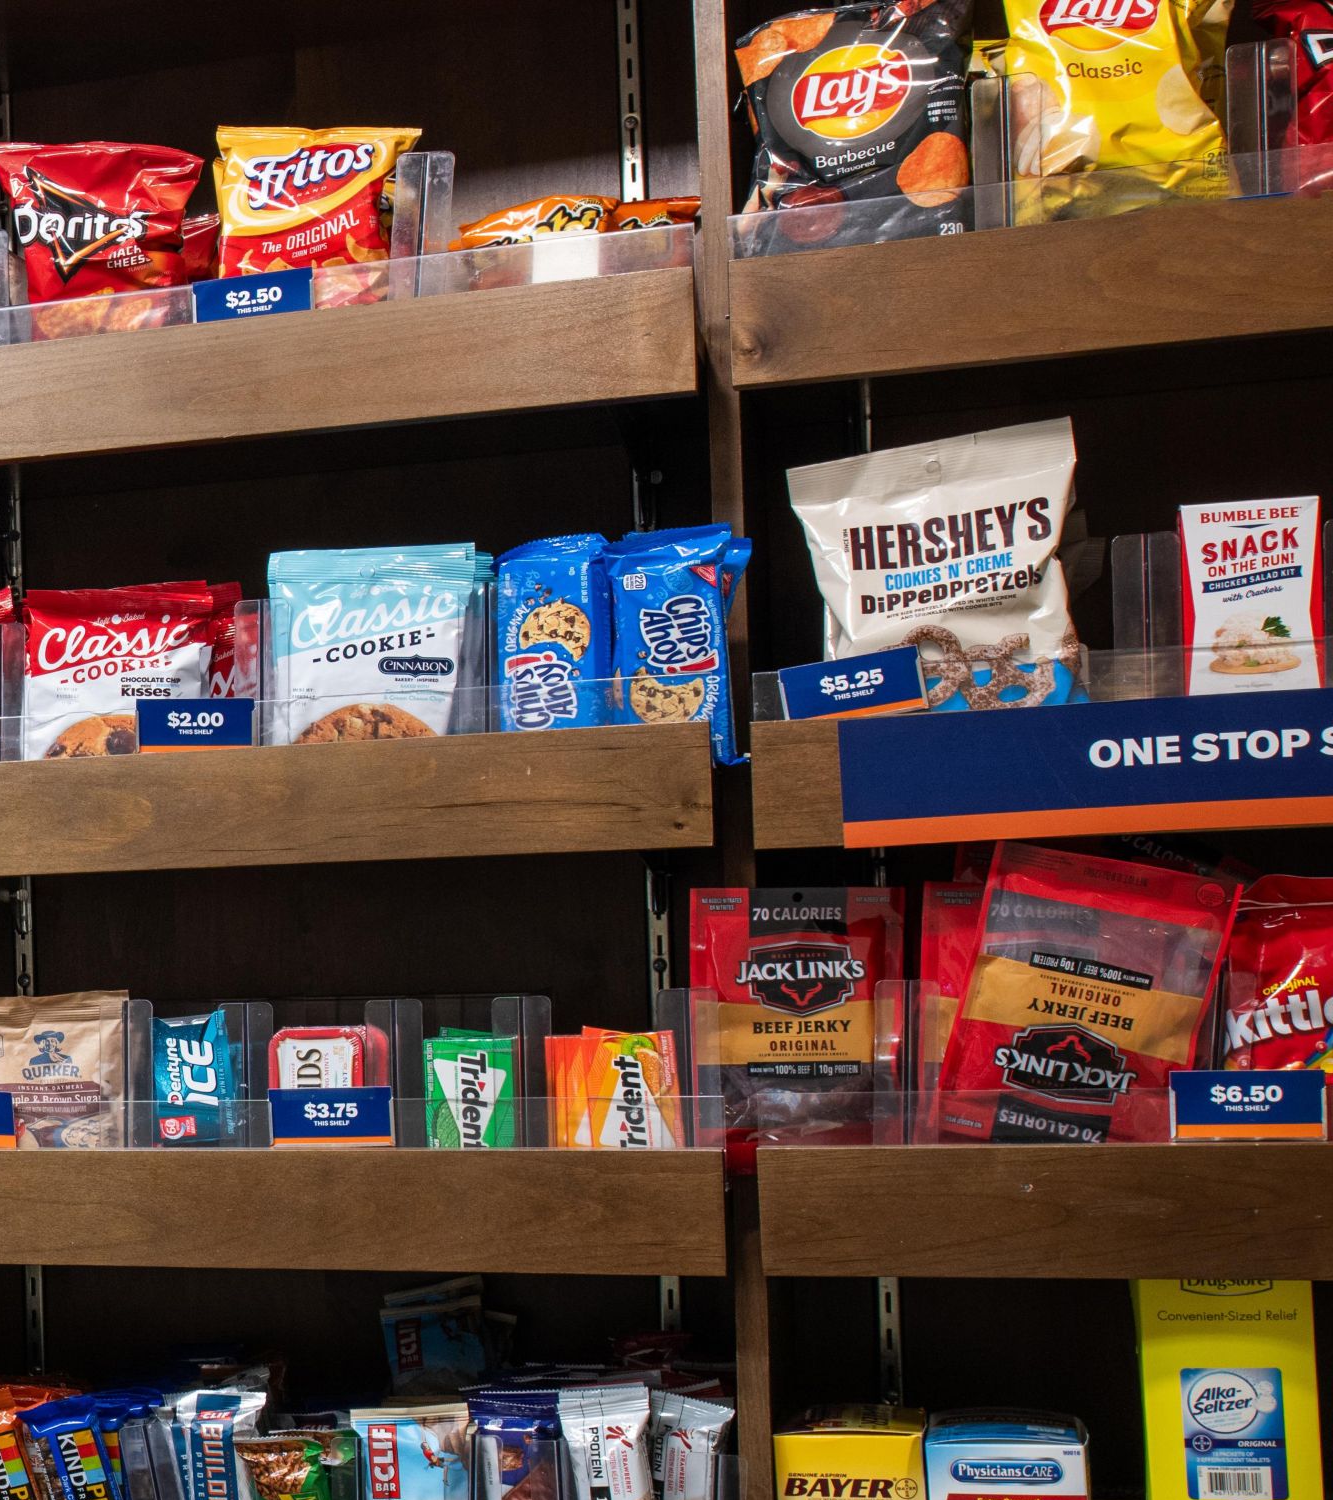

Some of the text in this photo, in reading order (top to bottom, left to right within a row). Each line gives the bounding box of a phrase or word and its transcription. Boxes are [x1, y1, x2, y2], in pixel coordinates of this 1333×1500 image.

[1066, 58, 1143, 79] Classic
[801, 60, 905, 119] Lay's
[815, 141, 896, 170] Barbecue
[835, 157, 877, 177] Flavored
[244, 143, 375, 210] Fritos
[13, 203, 155, 245] Doritos
[261, 208, 361, 255] The ORIGINAL
[291, 242, 328, 259] CORN CHIPS
[225, 286, 283, 309] $2.50
[236, 304, 273, 315] THIS SHELF
[1200, 506, 1300, 524] BUMBLE BEE
[849, 496, 1052, 571] HERSHEY'S
[1201, 527, 1299, 564] SNACK
[885, 566, 942, 592] COOKIES
[966, 552, 1014, 576] CREME
[1208, 552, 1295, 578] ON THE RUN!
[1208, 568, 1296, 590] CHICKEN SALAD KIT
[1222, 585, 1284, 603] with Crackers
[291, 585, 459, 650] Classic
[663, 594, 711, 661] Chips
[37, 614, 190, 672] Classic
[326, 630, 422, 664] COOKIE
[640, 608, 720, 674] Ahoy!
[383, 659, 449, 673] CINNABON
[819, 667, 885, 696] $5.25
[167, 710, 224, 729] $2.00
[1089, 727, 1311, 768] ONE STOP
[752, 906, 842, 921] 70 CALORIES
[736, 959, 865, 983] JACK LINK'S
[753, 1019, 852, 1034] BEEF JERKY
[769, 1039, 837, 1052] ORIGINAL
[21, 1062, 81, 1080] QUAKER
[166, 1038, 184, 1106] Dentyne
[179, 1039, 219, 1106] ICE
[1210, 1084, 1284, 1105] $6.50
[303, 1102, 358, 1120] $3.75
[1157, 1308, 1298, 1322] Convenient-Sized Relief
[1196, 1386, 1242, 1402] Alka-
[1192, 1397, 1252, 1415] Seltzer
[372, 1428, 395, 1482] CLIF
[1237, 1440, 1277, 1448] ORIGINAL
[57, 1433, 87, 1488] KIND
[375, 1482, 397, 1492] BAR
[784, 1477, 893, 1499] BAYER
